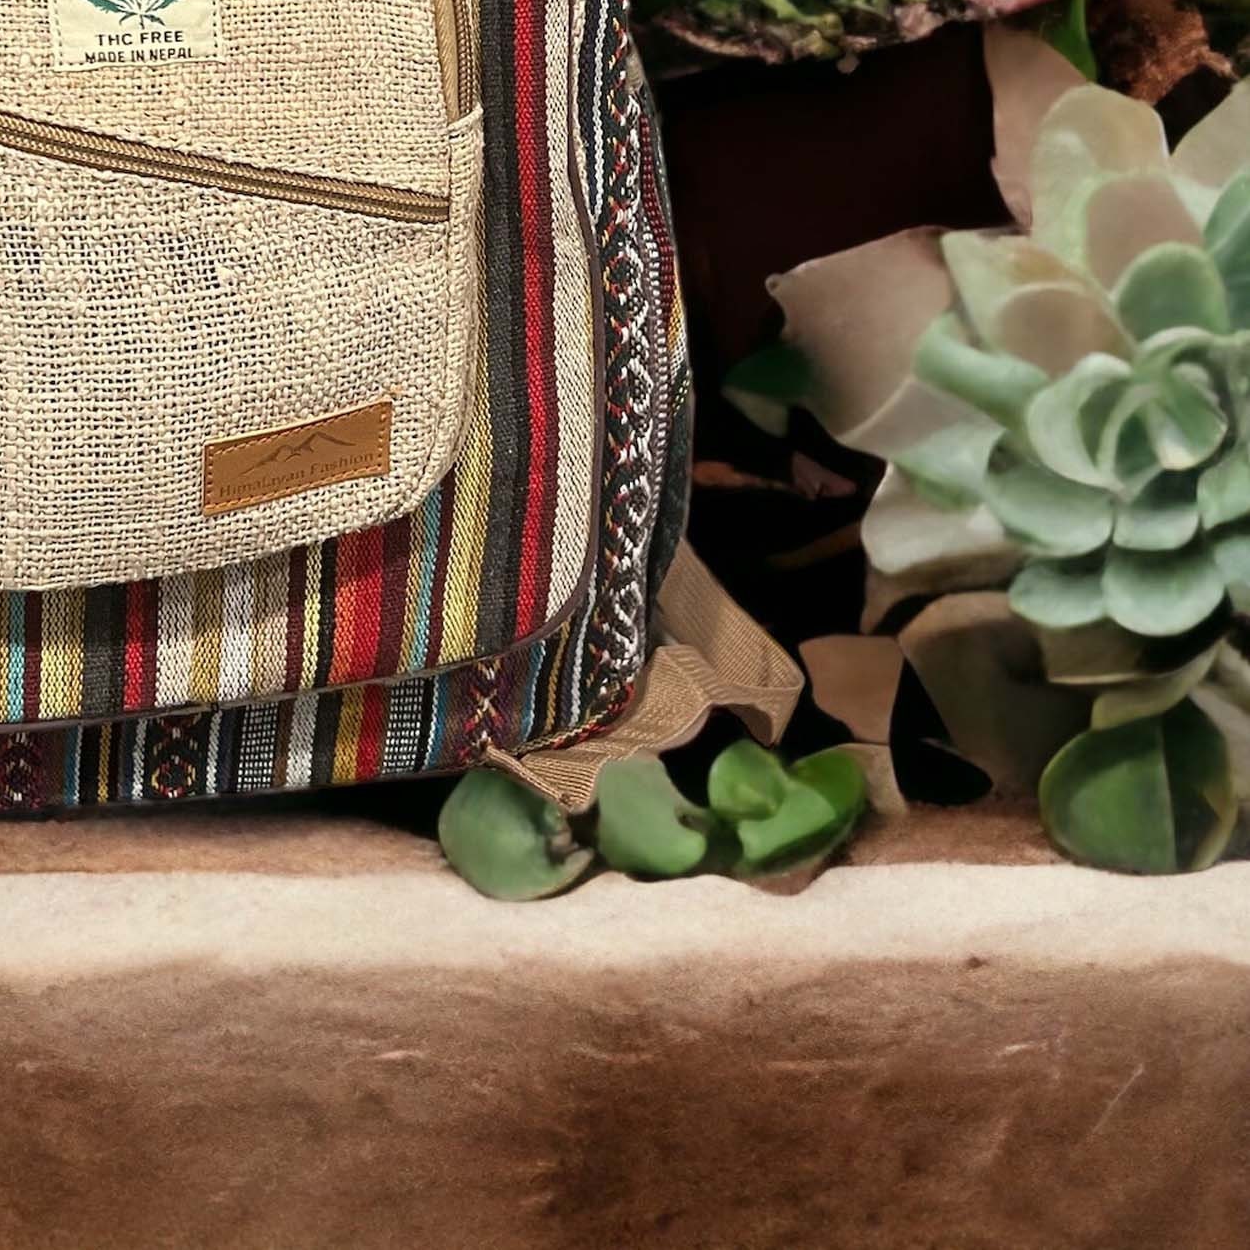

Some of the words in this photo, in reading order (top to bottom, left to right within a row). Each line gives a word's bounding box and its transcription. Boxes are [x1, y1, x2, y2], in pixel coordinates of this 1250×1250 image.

[96, 33, 133, 46] THC
[140, 31, 184, 45] FREE
[85, 50, 125, 63] MADE
[131, 50, 144, 63] IN
[150, 47, 193, 62] NEPAL
[310, 451, 374, 475] Fashion
